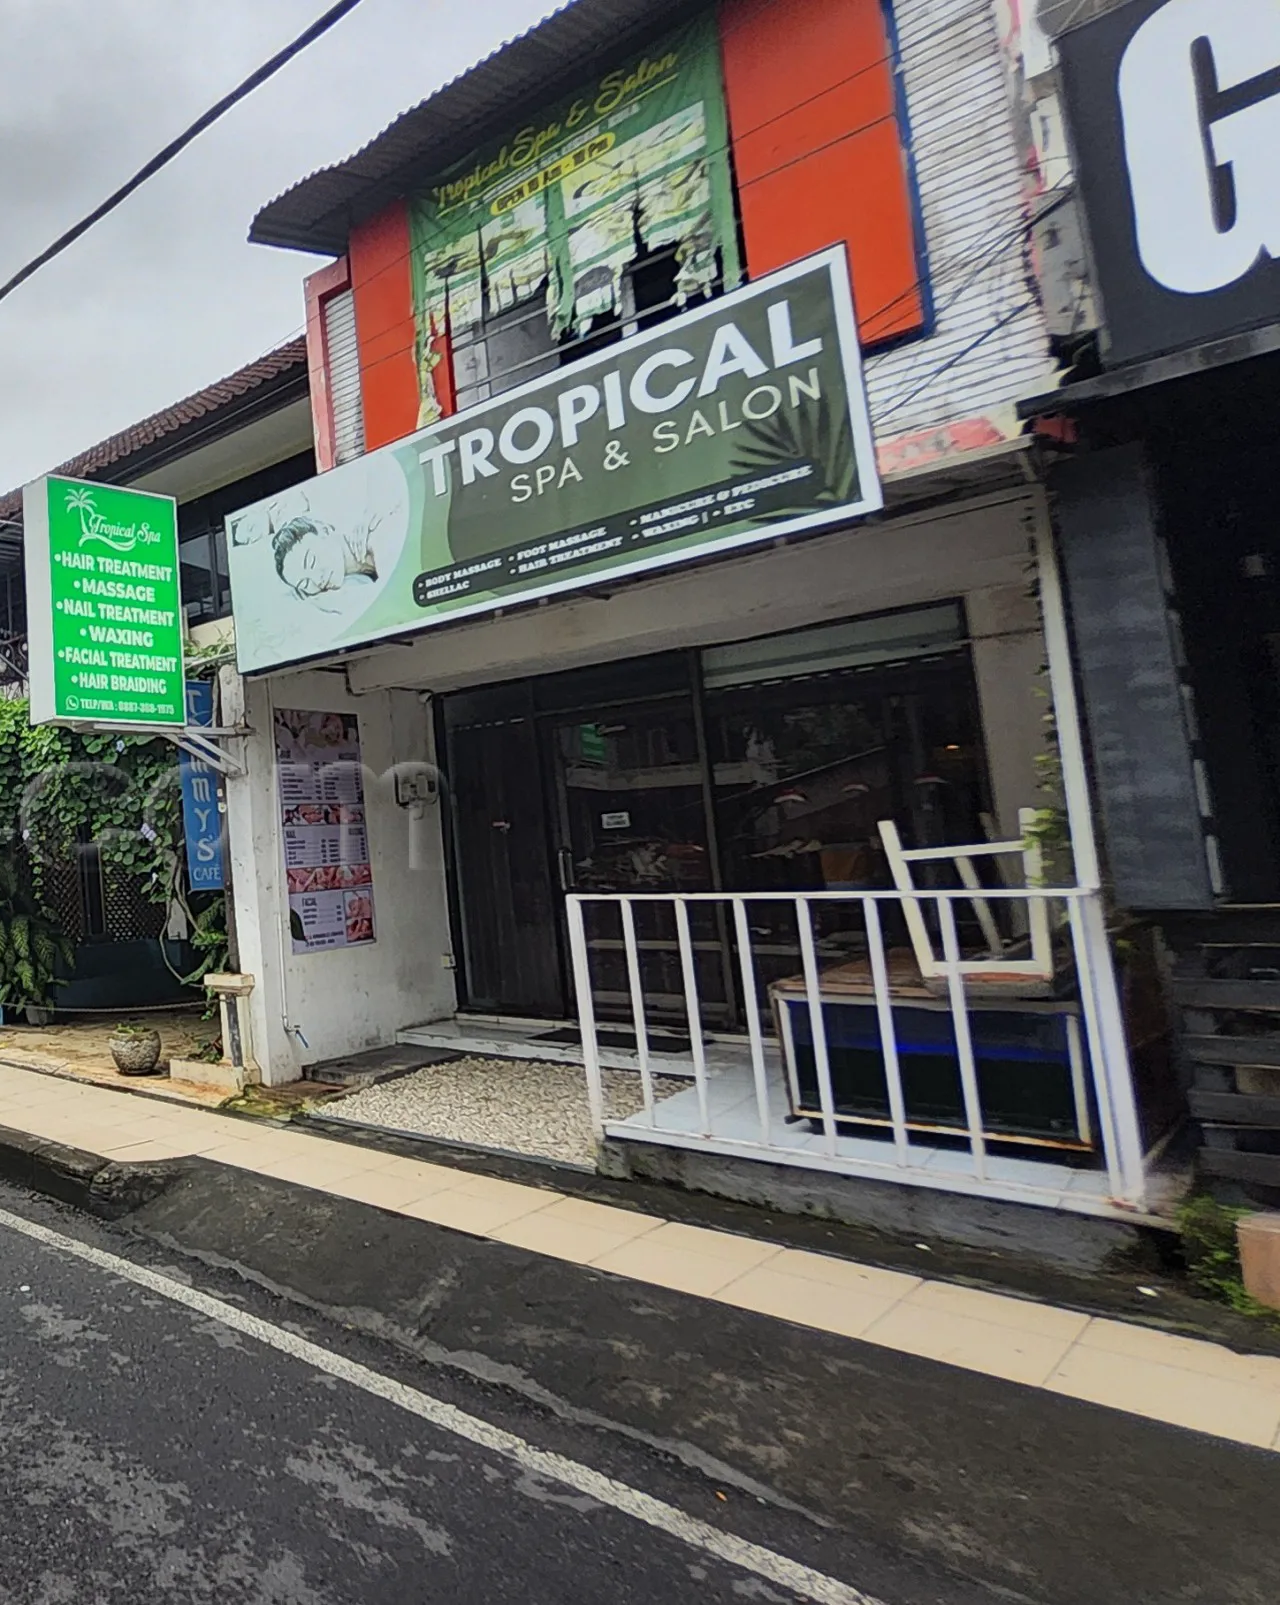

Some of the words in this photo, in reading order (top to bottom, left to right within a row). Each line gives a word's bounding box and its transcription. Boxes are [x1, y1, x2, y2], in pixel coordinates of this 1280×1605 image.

[509, 126, 561, 168] Spa
[566, 99, 590, 127] &
[595, 51, 678, 114] Salon
[420, 300, 823, 498] TROPICAL
[509, 457, 583, 503] SPA
[603, 441, 631, 471] &
[653, 366, 823, 454] SALON
[90, 513, 135, 540] Tropical
[137, 521, 161, 546] Spa
[426, 580, 471, 600] SHELLAC
[518, 557, 548, 575] HAIR
[548, 536, 624, 567] TREATMENT
[724, 498, 756, 517] ETC
[426, 570, 452, 588] BODY
[453, 557, 503, 581] MASSAGE
[517, 547, 546, 562] FOOT
[548, 526, 608, 553] MASSAGE
[62, 551, 95, 571] HAIR
[97, 556, 173, 582] TREATMENT
[83, 577, 156, 603] MASSAGE
[64, 598, 96, 619] NAIL
[98, 602, 175, 627] TREATMENT
[89, 625, 154, 648] WAXING
[66, 646, 108, 667] FACIAL
[109, 653, 177, 673] TREATMENT
[79, 671, 109, 690] HAIR
[111, 674, 167, 695] BRAIDING
